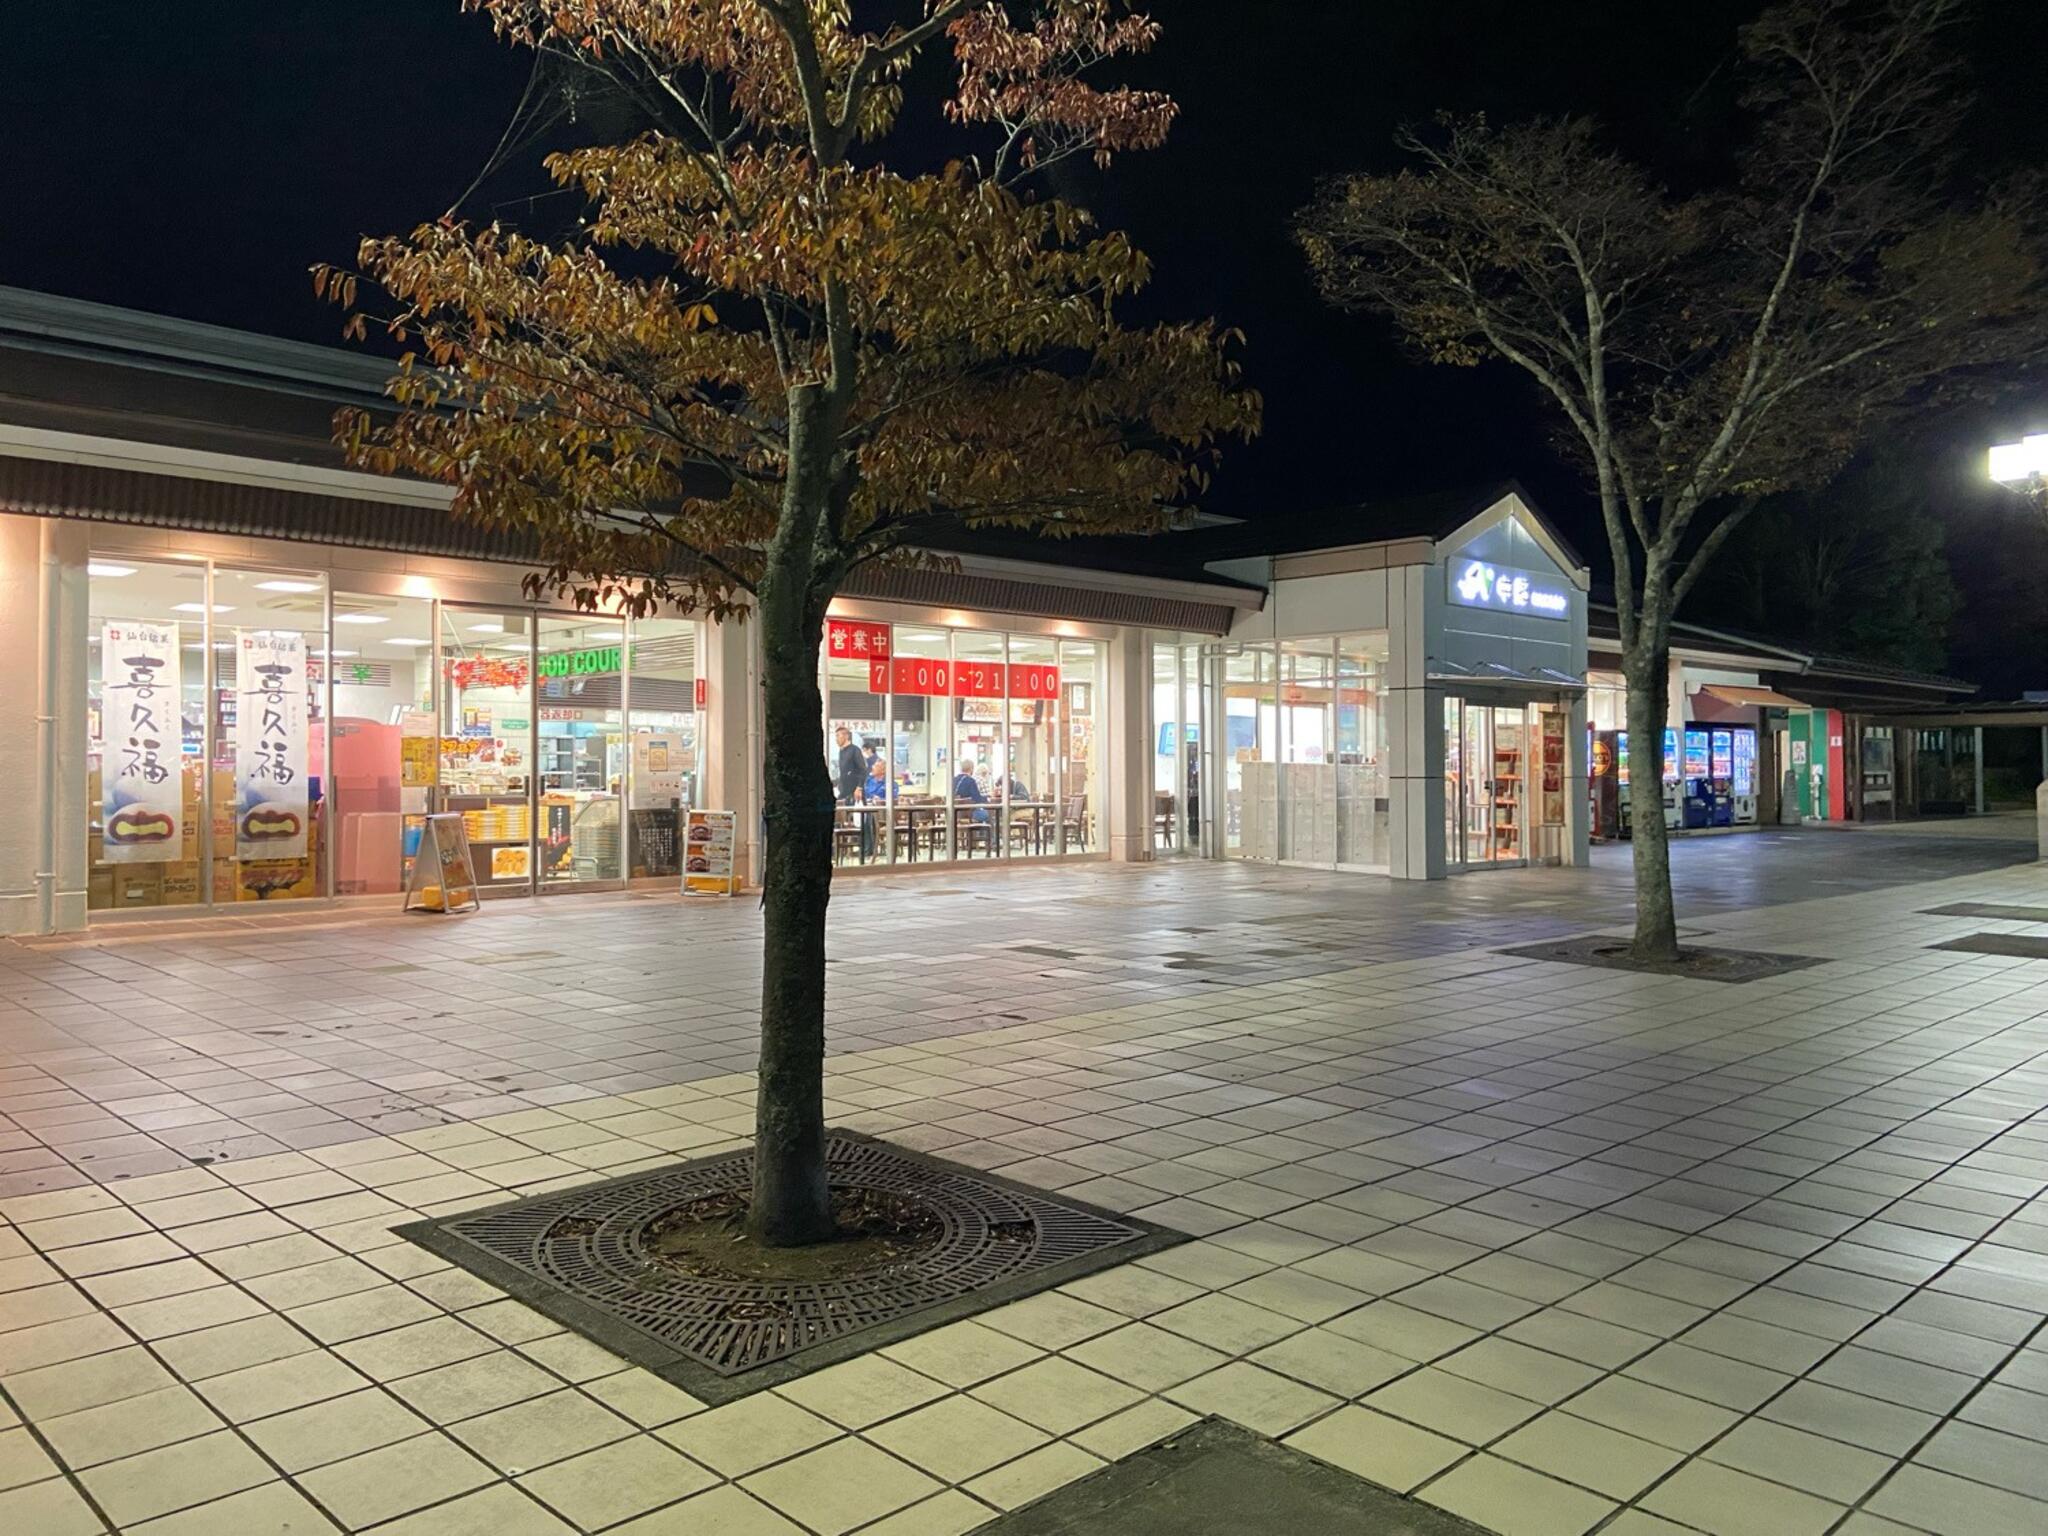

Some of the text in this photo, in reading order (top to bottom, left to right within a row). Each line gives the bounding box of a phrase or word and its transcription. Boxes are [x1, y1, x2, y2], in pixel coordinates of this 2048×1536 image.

[538, 652, 568, 677] OOD
[831, 628, 887, 653] 営業中
[109, 653, 173, 785] 喜久福
[243, 661, 300, 785] 喜久福
